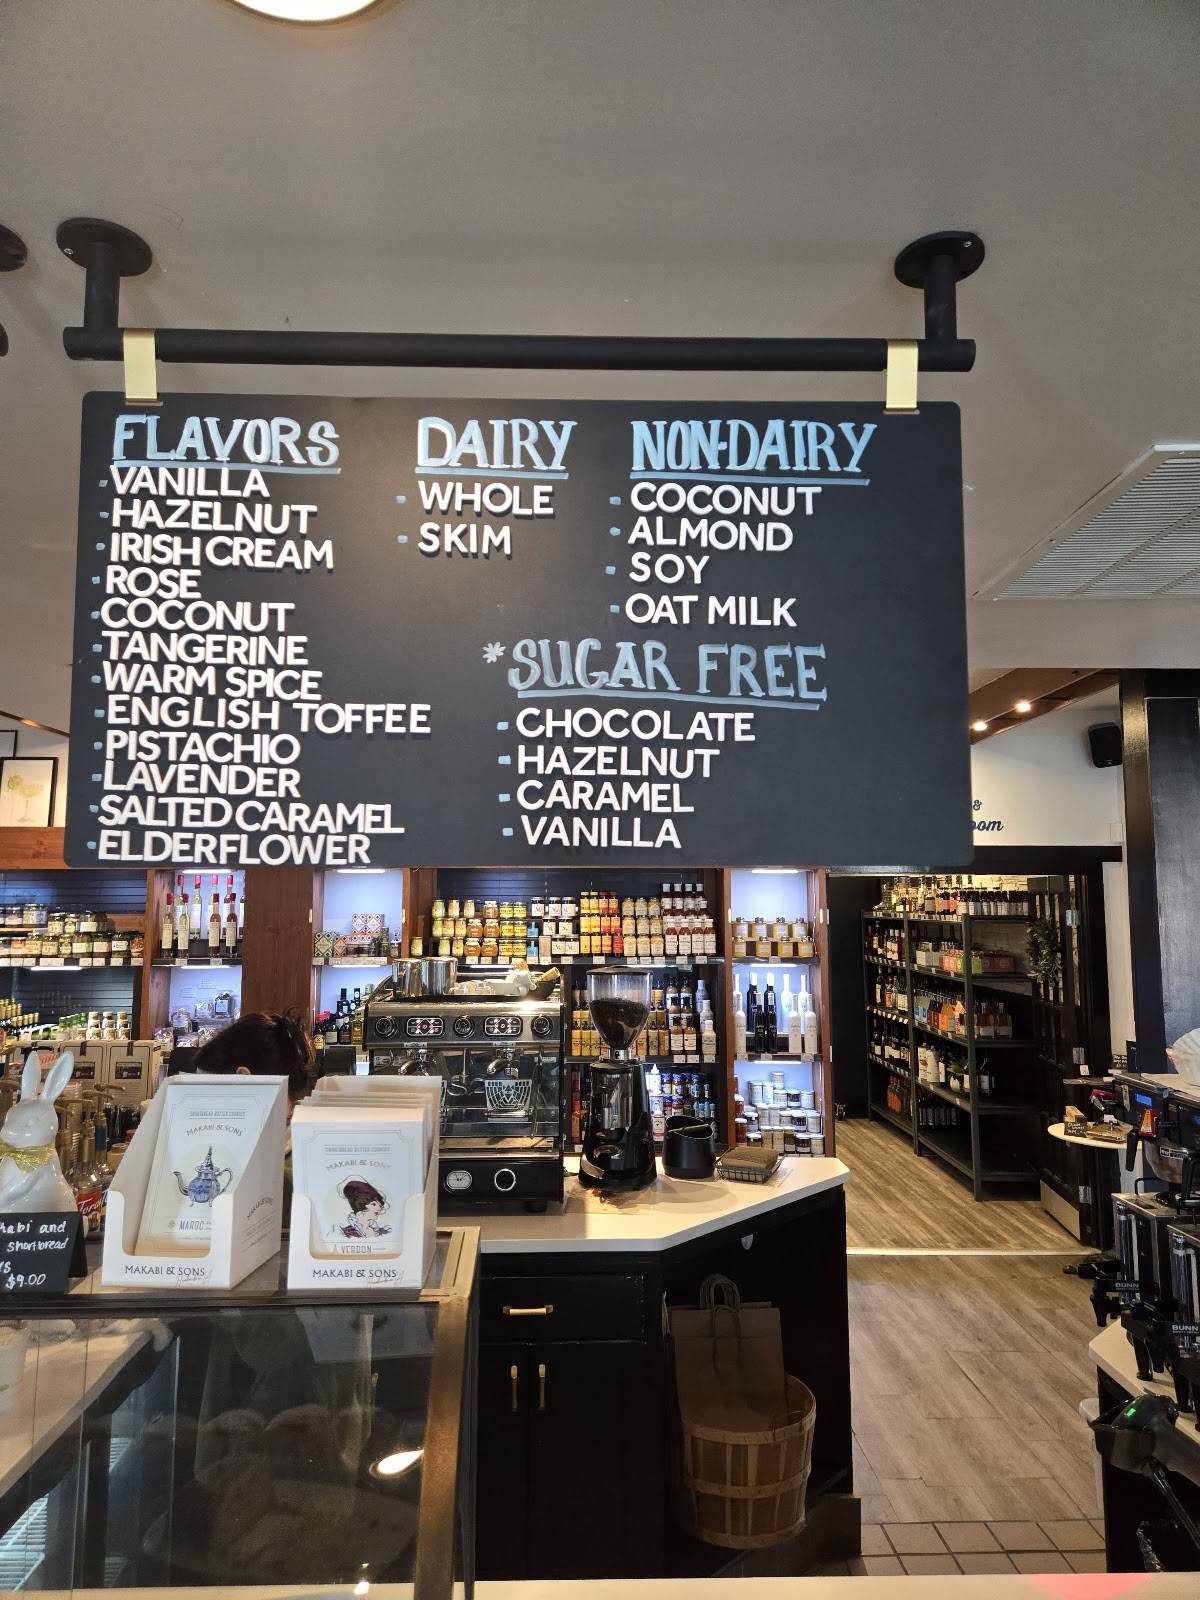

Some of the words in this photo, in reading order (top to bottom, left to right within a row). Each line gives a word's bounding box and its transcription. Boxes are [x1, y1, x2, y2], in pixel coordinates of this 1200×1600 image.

[111, 414, 340, 467] FLAVORS
[417, 416, 578, 471] DAIRY
[630, 418, 878, 473] NON-DAIRY
[110, 465, 270, 498] VANILLA
[418, 481, 554, 515] WHOLE
[630, 482, 822, 515] COCONUT
[112, 498, 318, 535] HAZELNUT
[627, 516, 794, 552] ALMOND
[110, 532, 201, 566] IRISH
[205, 535, 334, 570] CREAM
[417, 522, 512, 555] SKIM
[106, 564, 202, 600] ROSE
[629, 552, 710, 584] SOY
[101, 597, 296, 632] COCONUT
[625, 593, 699, 625] OAT
[707, 596, 798, 627] MILK
[101, 630, 309, 666] TANGERINE
[102, 661, 216, 696] WARM
[224, 667, 323, 701] SPICE
[508, 639, 682, 690] SUGAR
[697, 643, 828, 702] FREE
[107, 694, 280, 731] ENGLISH
[292, 702, 432, 734] TOFFEE
[516, 707, 756, 742] CHOCOLATE
[105, 730, 301, 765] PISTACHIO
[517, 745, 721, 779] HAZELNUT
[103, 760, 301, 798] LAVENDER
[516, 780, 695, 813] CARAMEL
[97, 795, 233, 828] SALTED
[235, 800, 405, 834] CARAMEL
[972, 799, 982, 811] &
[98, 830, 371, 865] ELDERFLOWER
[520, 815, 682, 849] VANILLA
[40, 1220, 67, 1233] and
[6, 1273, 46, 1289] $9.00
[125, 1265, 163, 1275] MAKABI
[166, 1266, 176, 1275] &
[178, 1266, 205, 1276] SONS
[312, 1269, 353, 1278] MAKABI
[356, 1269, 366, 1278] &
[369, 1269, 397, 1278] SONS
[1172, 1324, 1199, 1332] BUNN
